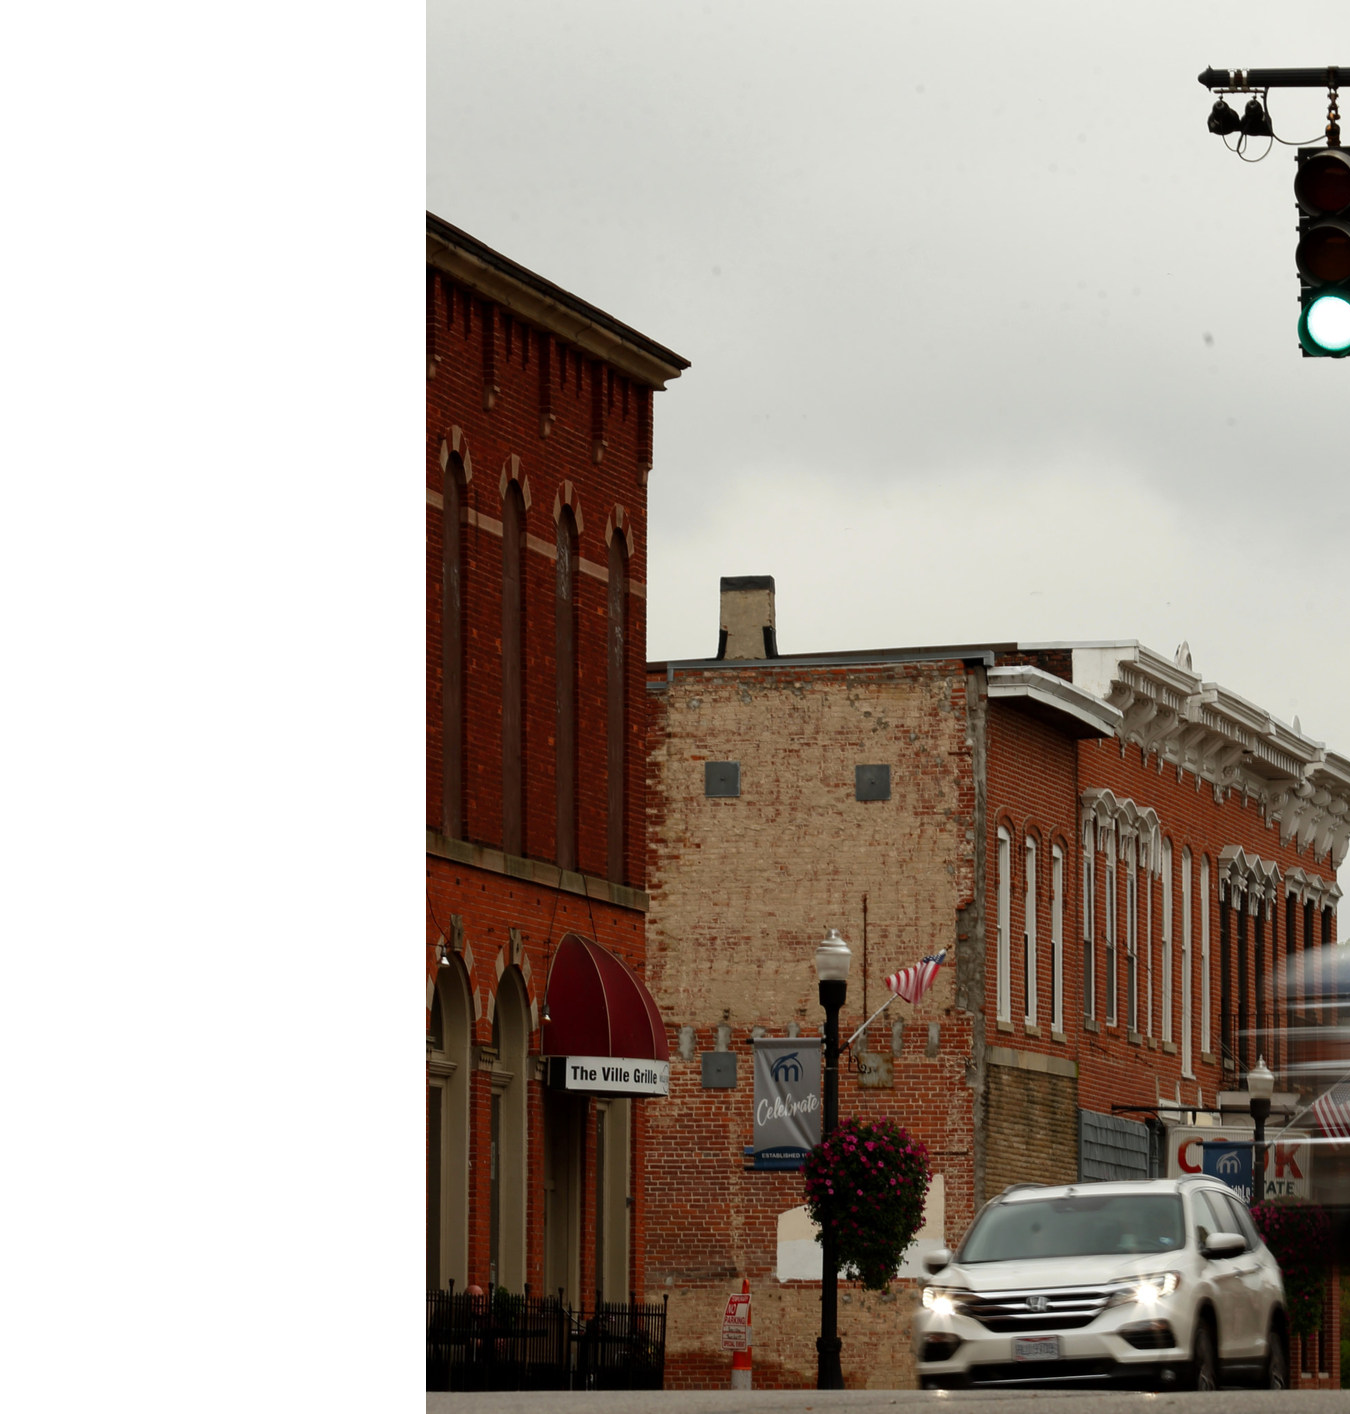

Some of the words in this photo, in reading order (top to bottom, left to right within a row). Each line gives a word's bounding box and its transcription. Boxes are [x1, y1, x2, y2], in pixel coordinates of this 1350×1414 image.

[571, 1065, 597, 1081] The
[601, 1066, 630, 1083] Ville
[633, 1068, 658, 1085] Grille
[756, 1092, 820, 1126] Celebrate
[727, 1303, 737, 1314] NO
[724, 1316, 746, 1325] PARKING
